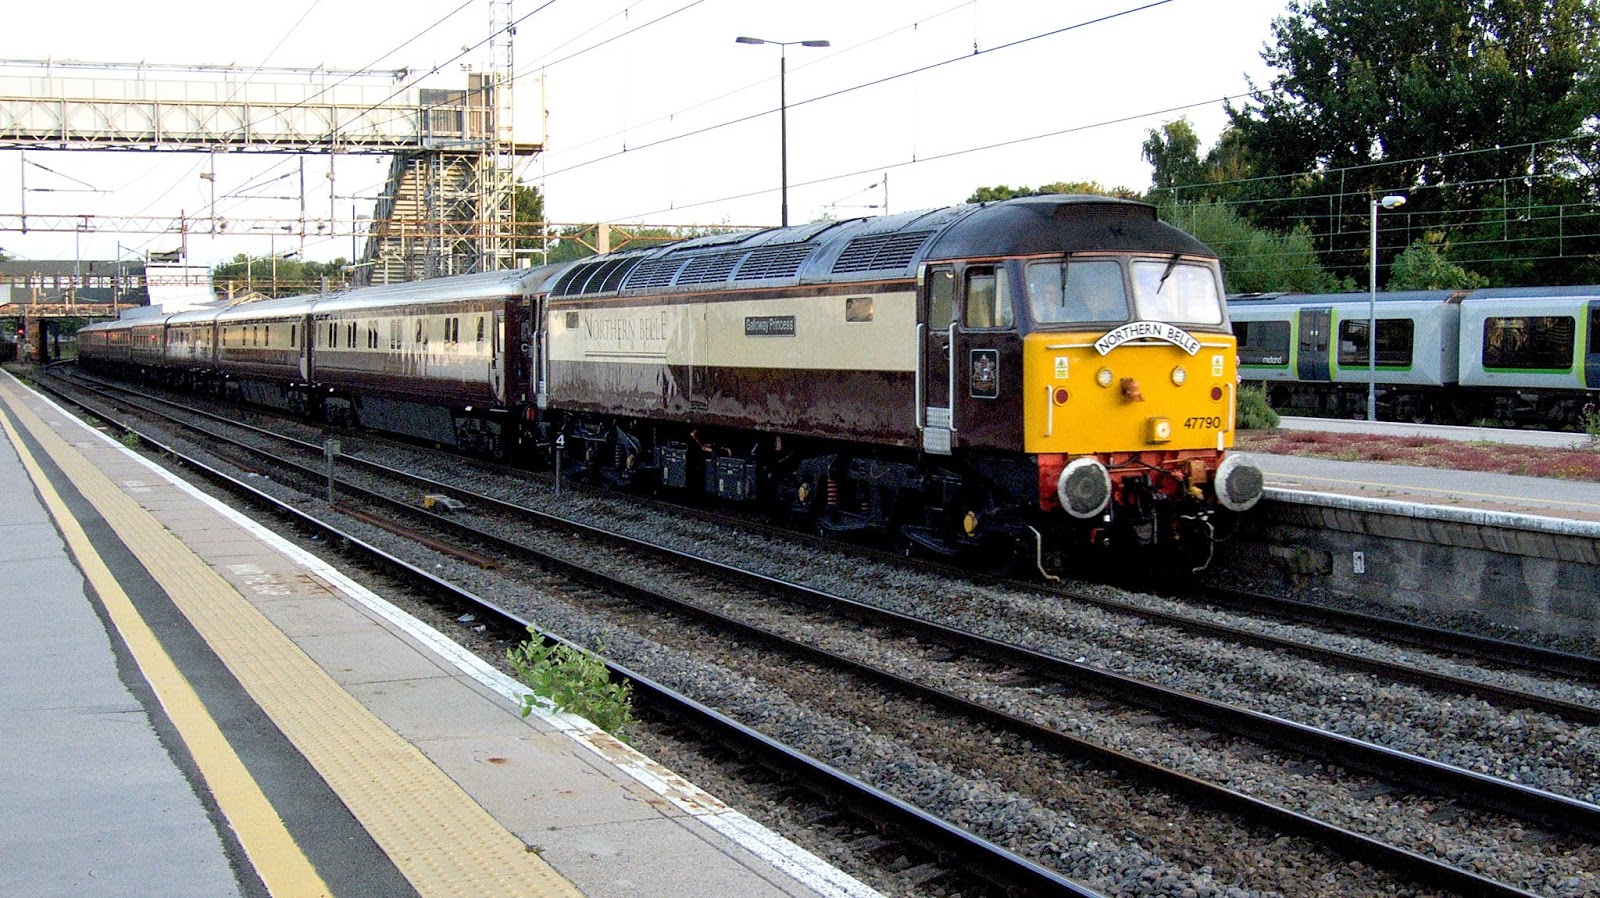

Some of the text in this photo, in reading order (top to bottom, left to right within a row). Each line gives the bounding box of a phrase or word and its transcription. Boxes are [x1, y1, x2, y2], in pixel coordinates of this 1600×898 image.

[584, 311, 666, 341] NORTHERN BELLE
[746, 318, 794, 333] Galloway Princess
[1098, 323, 1198, 353] NORTHERN BELLE
[1184, 416, 1221, 429] 47790
[555, 434, 565, 446] 4
